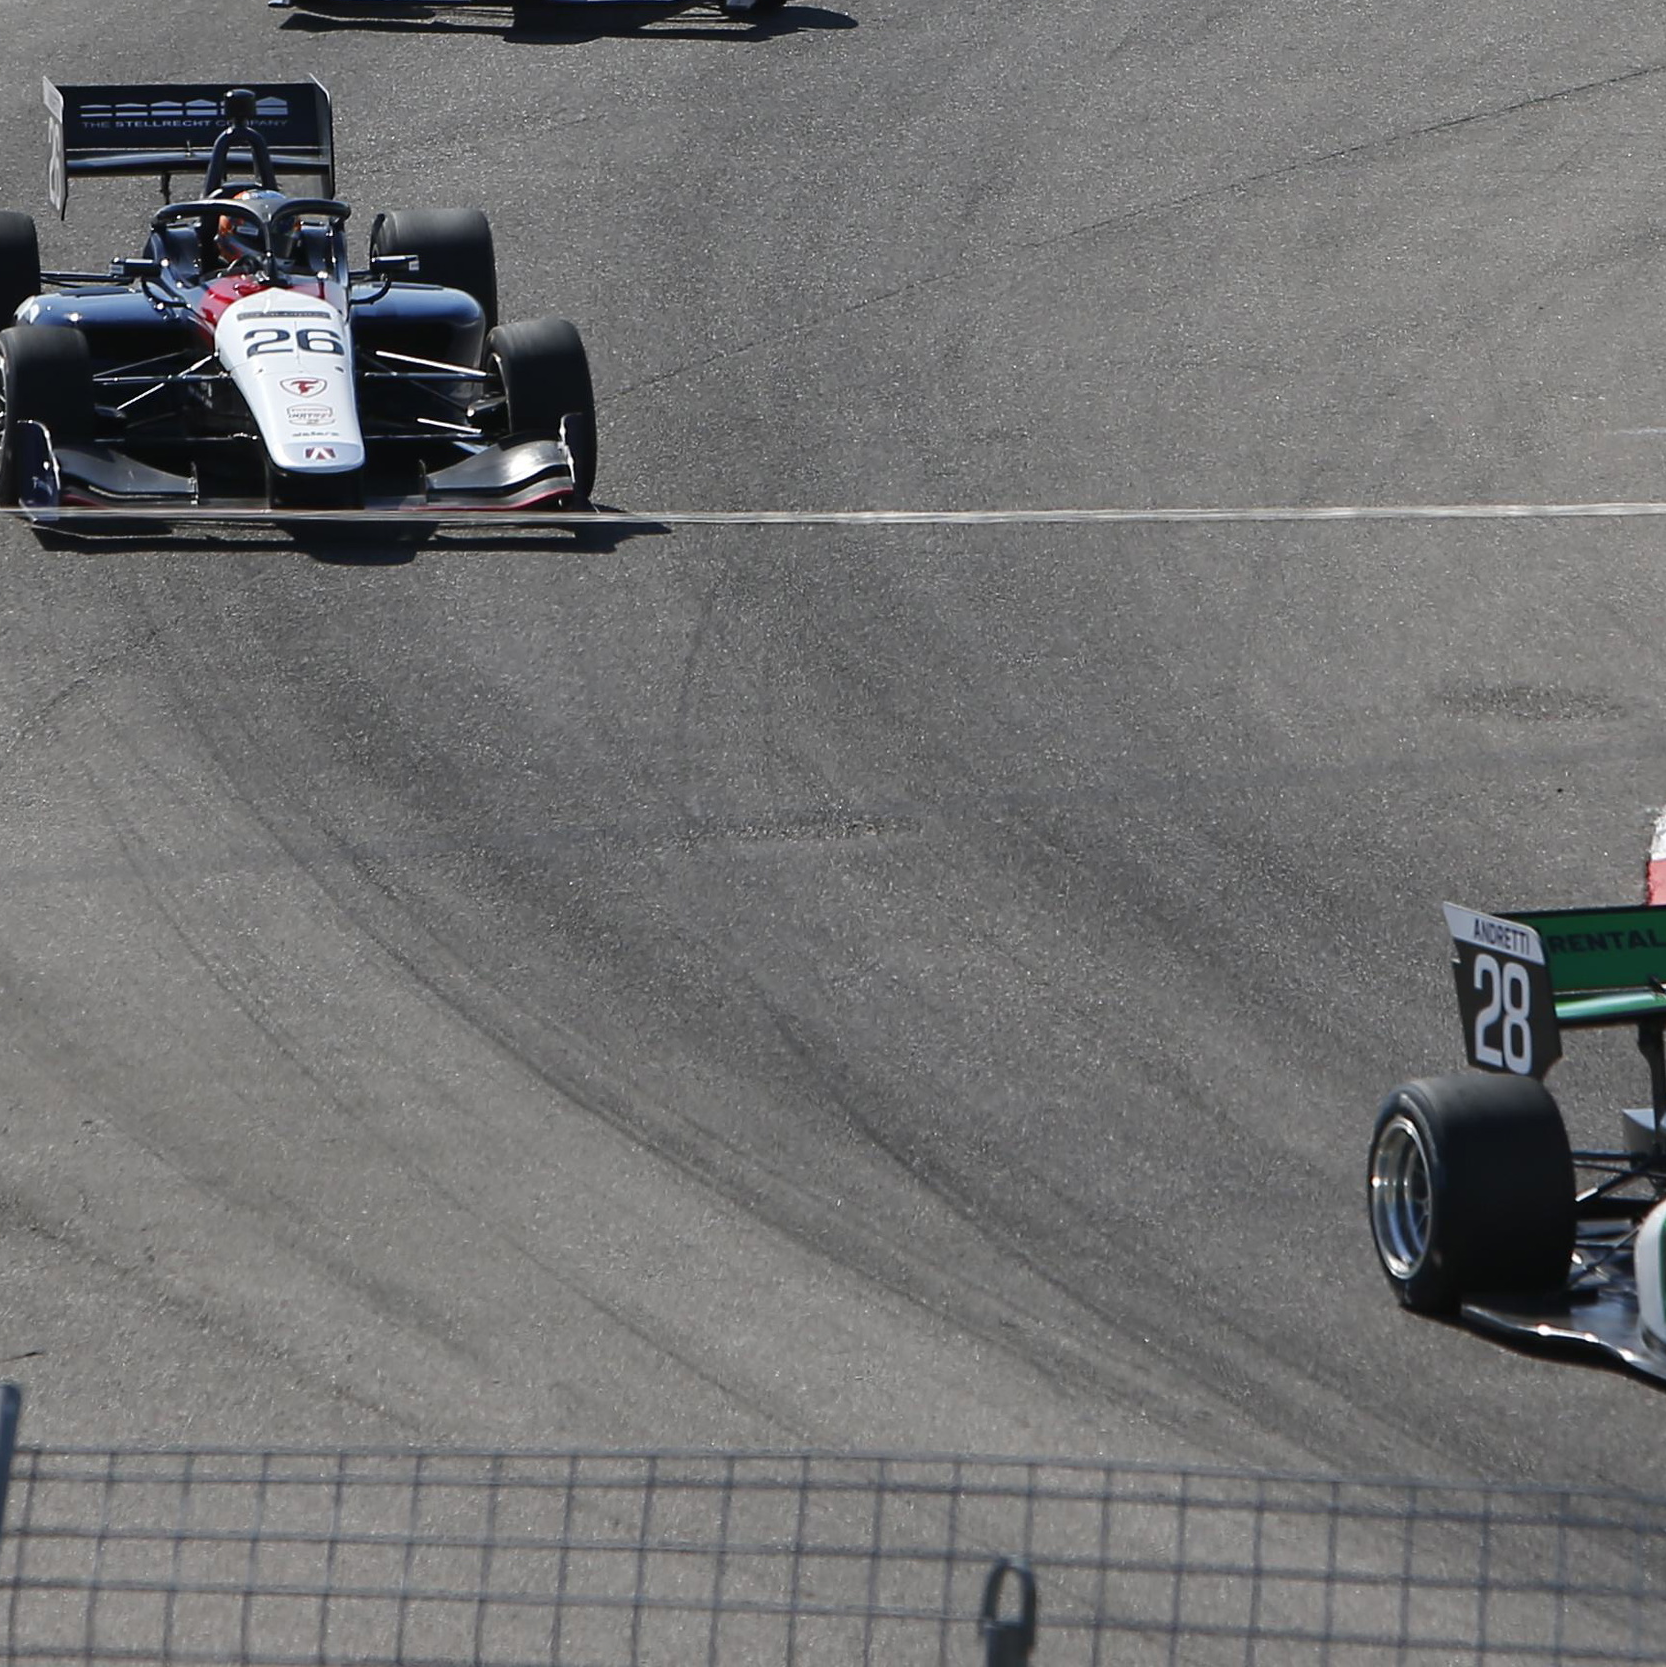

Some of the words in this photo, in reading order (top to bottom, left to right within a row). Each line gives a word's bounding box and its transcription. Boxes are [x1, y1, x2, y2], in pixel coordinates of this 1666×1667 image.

[82, 120, 112, 129] THE
[114, 119, 212, 128] STELLRECHT
[243, 328, 345, 359] 26
[1474, 917, 1531, 956] ANDRETTI
[1473, 953, 1533, 1075] 28
